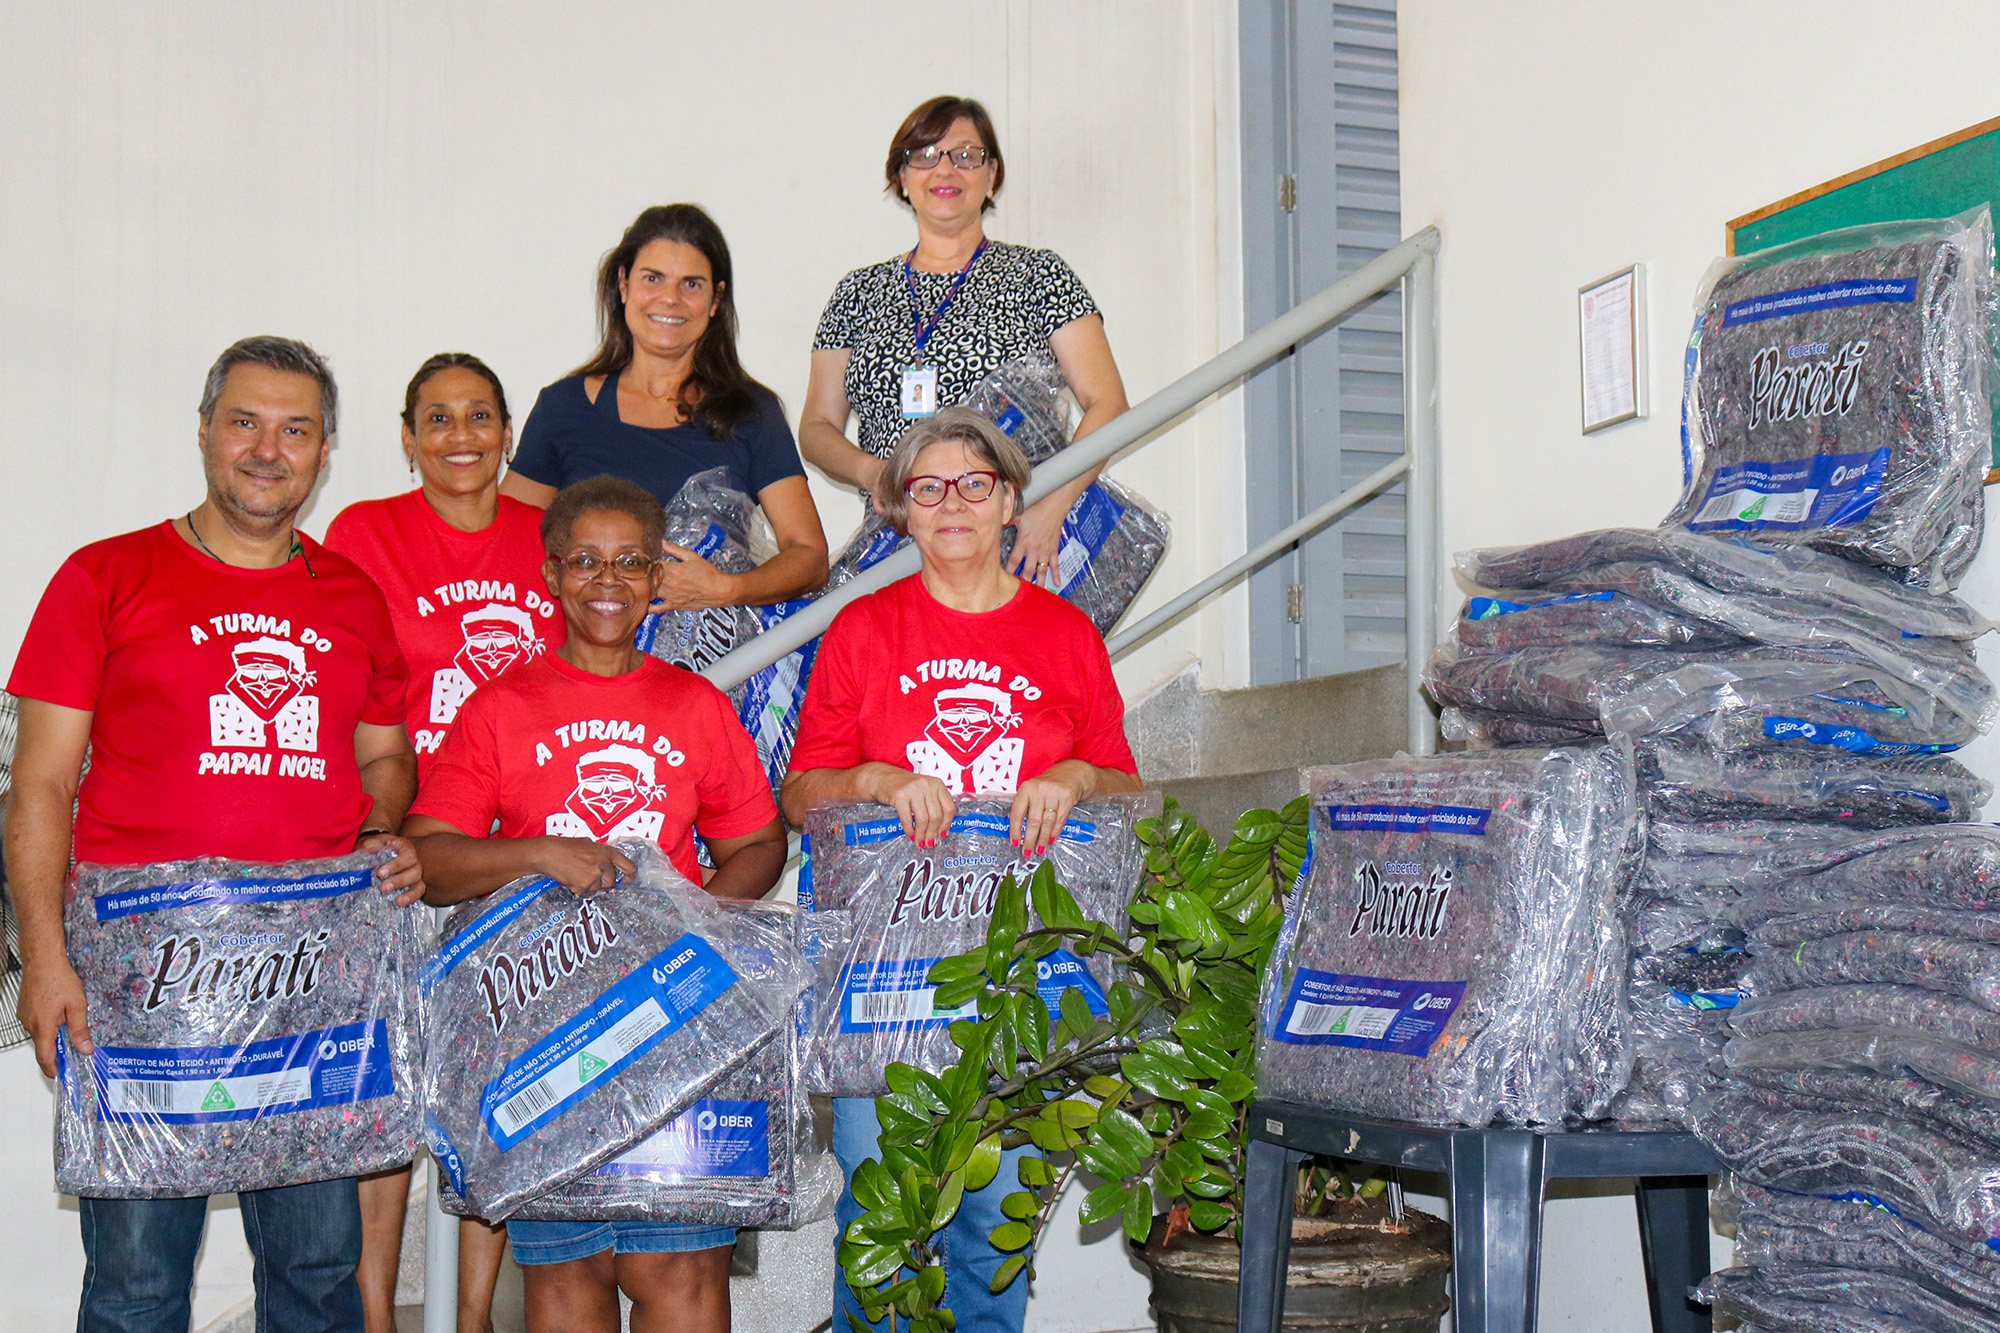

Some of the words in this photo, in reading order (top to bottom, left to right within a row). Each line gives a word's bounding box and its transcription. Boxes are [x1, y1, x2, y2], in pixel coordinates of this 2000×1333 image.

[1884, 284, 1907, 294] Brasil
[1748, 340, 1870, 430] Parati
[416, 596, 436, 617] A
[434, 579, 516, 606] TURMA
[524, 590, 555, 618] DO
[190, 625, 209, 645] A
[209, 613, 291, 637] TURMA
[300, 627, 333, 652] DO
[899, 674, 918, 695] A
[916, 658, 1002, 683] TURMA
[1008, 675, 1042, 701] DO
[535, 741, 553, 767] A
[554, 719, 646, 748] TURMA
[653, 735, 686, 767] DO
[198, 751, 273, 776] PAPAI
[278, 754, 327, 781] NOEL
[859, 828, 869, 837] Há
[870, 825, 886, 835] mais
[887, 823, 897, 833] de
[1062, 824, 1081, 833] rasil
[1457, 814, 1467, 825] do
[944, 854, 997, 869] Cobertor
[1385, 860, 1421, 875] Cobertor
[107, 900, 119, 911] Há
[120, 897, 138, 909] mais
[138, 895, 149, 905] de
[150, 892, 161, 903] 50
[161, 890, 181, 901] anos
[233, 887, 239, 895] o
[241, 884, 269, 895] melhor
[271, 882, 305, 893] cobertor
[306, 879, 340, 891] reciclado
[340, 877, 350, 887] do
[1348, 859, 1454, 941] Parati
[220, 932, 285, 947] Cobertor
[442, 953, 451, 964] de
[449, 946, 461, 958] 50
[459, 933, 476, 950] anos
[475, 905, 513, 938] produzindo
[513, 902, 519, 910] o
[143, 925, 331, 1014] Parati
[476, 898, 620, 1037] Parati
[663, 948, 697, 975] OBER
[1053, 961, 1083, 974] OBER
[1304, 980, 1331, 991] COBERTOR
[1428, 997, 1452, 1010] OBER
[339, 1036, 376, 1053] OBER
[514, 1068, 525, 1079] DE
[524, 1057, 539, 1072] NÃO
[537, 1042, 562, 1061] TECIDO
[563, 1017, 596, 1044] ANTIMOFO
[108, 1057, 148, 1067] COBERTOR
[147, 1059, 158, 1068] DE
[158, 1058, 175, 1068] NÃO
[176, 1058, 204, 1068] TECIDO
[253, 1049, 285, 1062] DURÁVEL
[507, 1084, 512, 1092] 1
[512, 1071, 535, 1090] Cobertor
[534, 1060, 550, 1074] Casal
[561, 1048, 568, 1056] m
[582, 1034, 589, 1043] m
[139, 1067, 165, 1075] Cobertor
[719, 1115, 753, 1128] OBER
